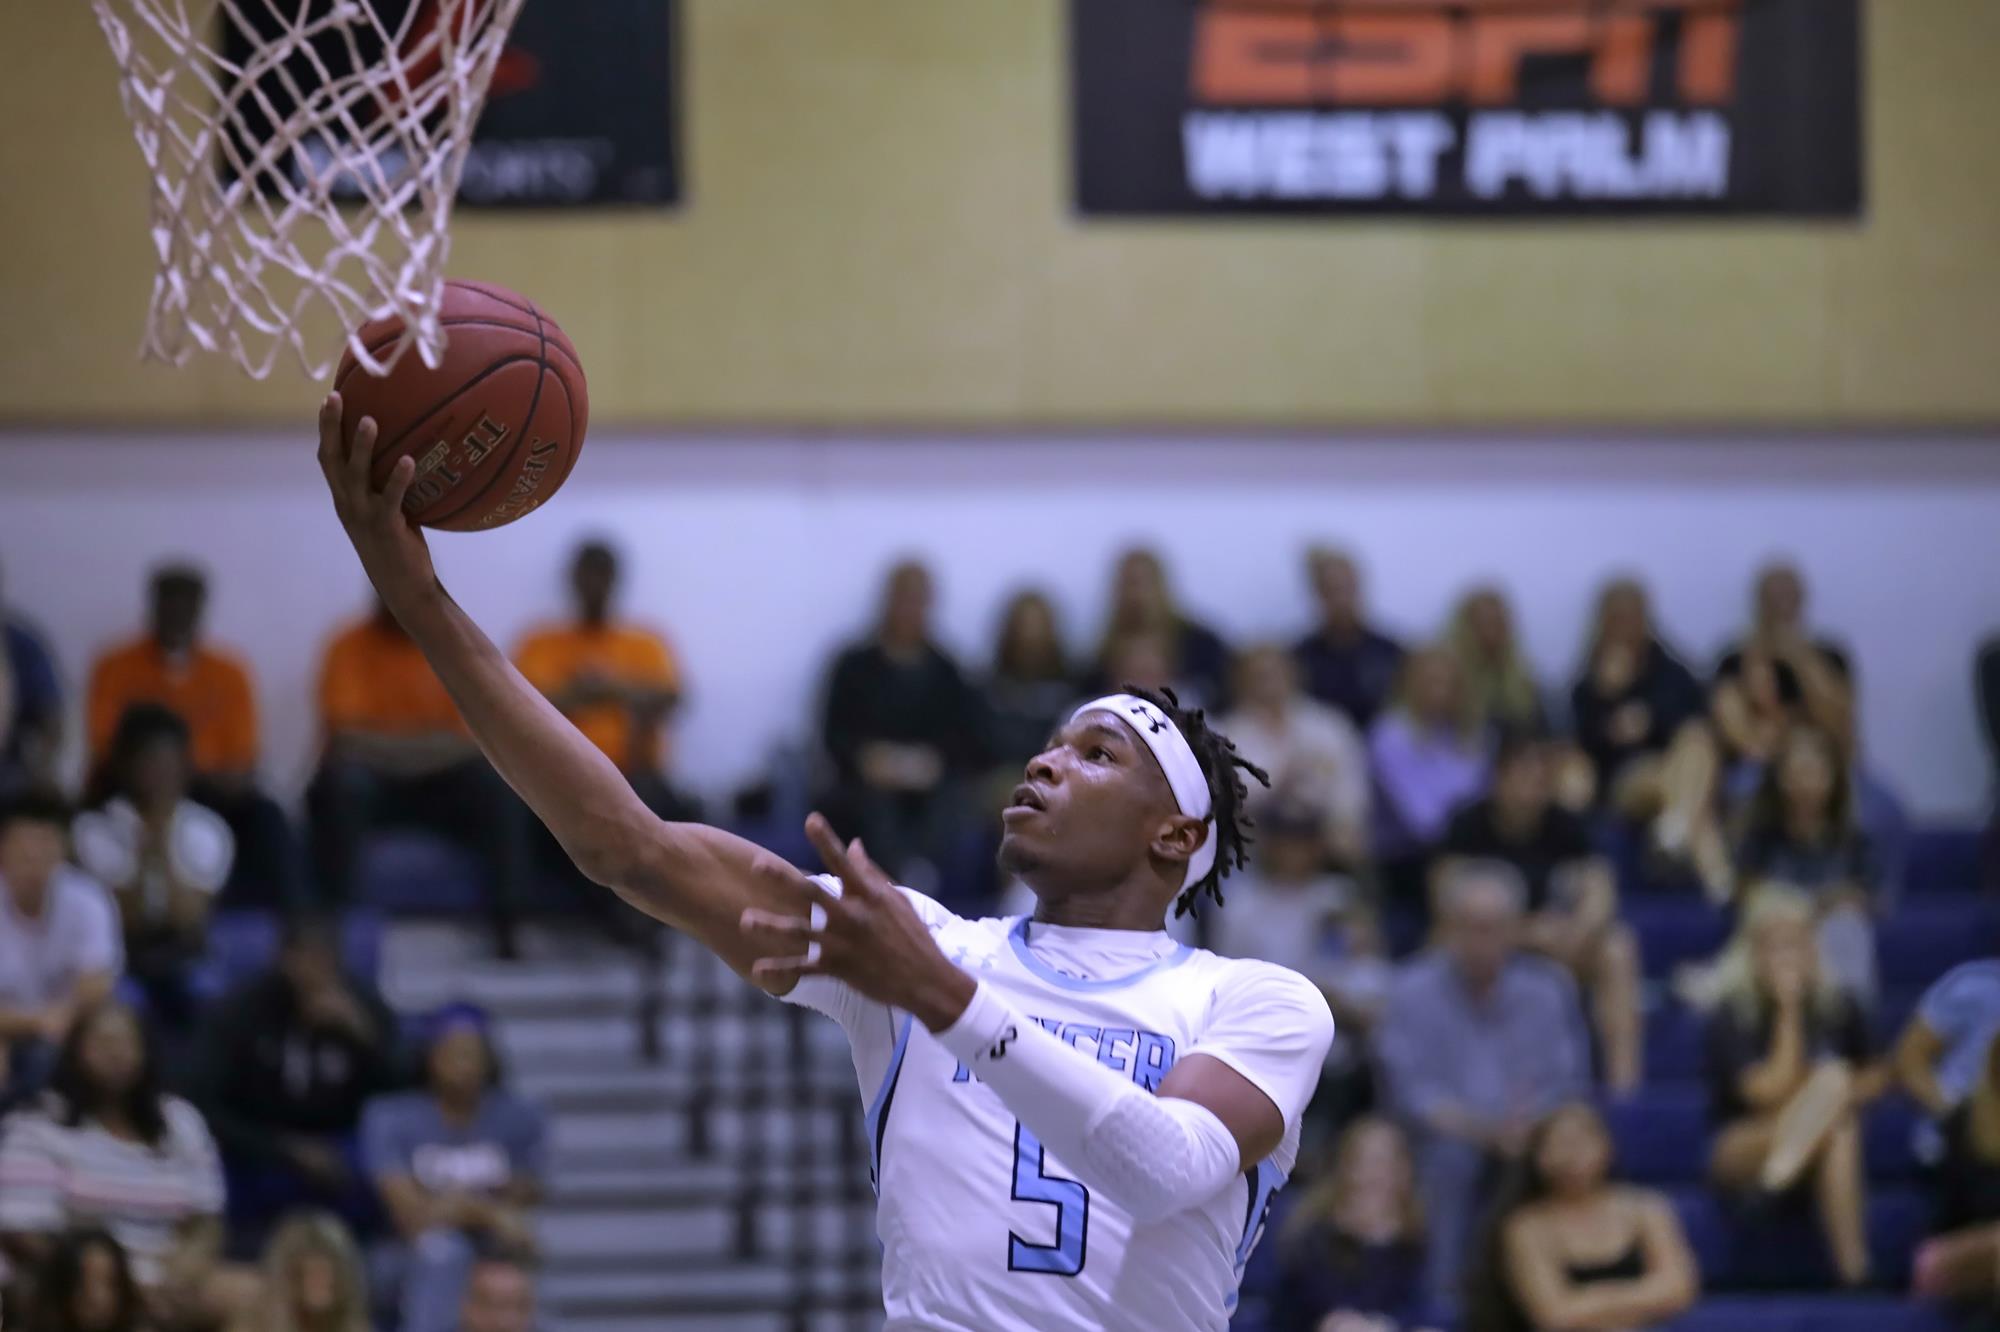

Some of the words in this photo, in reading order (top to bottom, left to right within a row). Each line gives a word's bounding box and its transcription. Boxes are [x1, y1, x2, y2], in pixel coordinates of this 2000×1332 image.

[1182, 110, 1457, 199] WEST
[1464, 110, 1732, 199] PALM
[1008, 1119, 1090, 1277] 5
